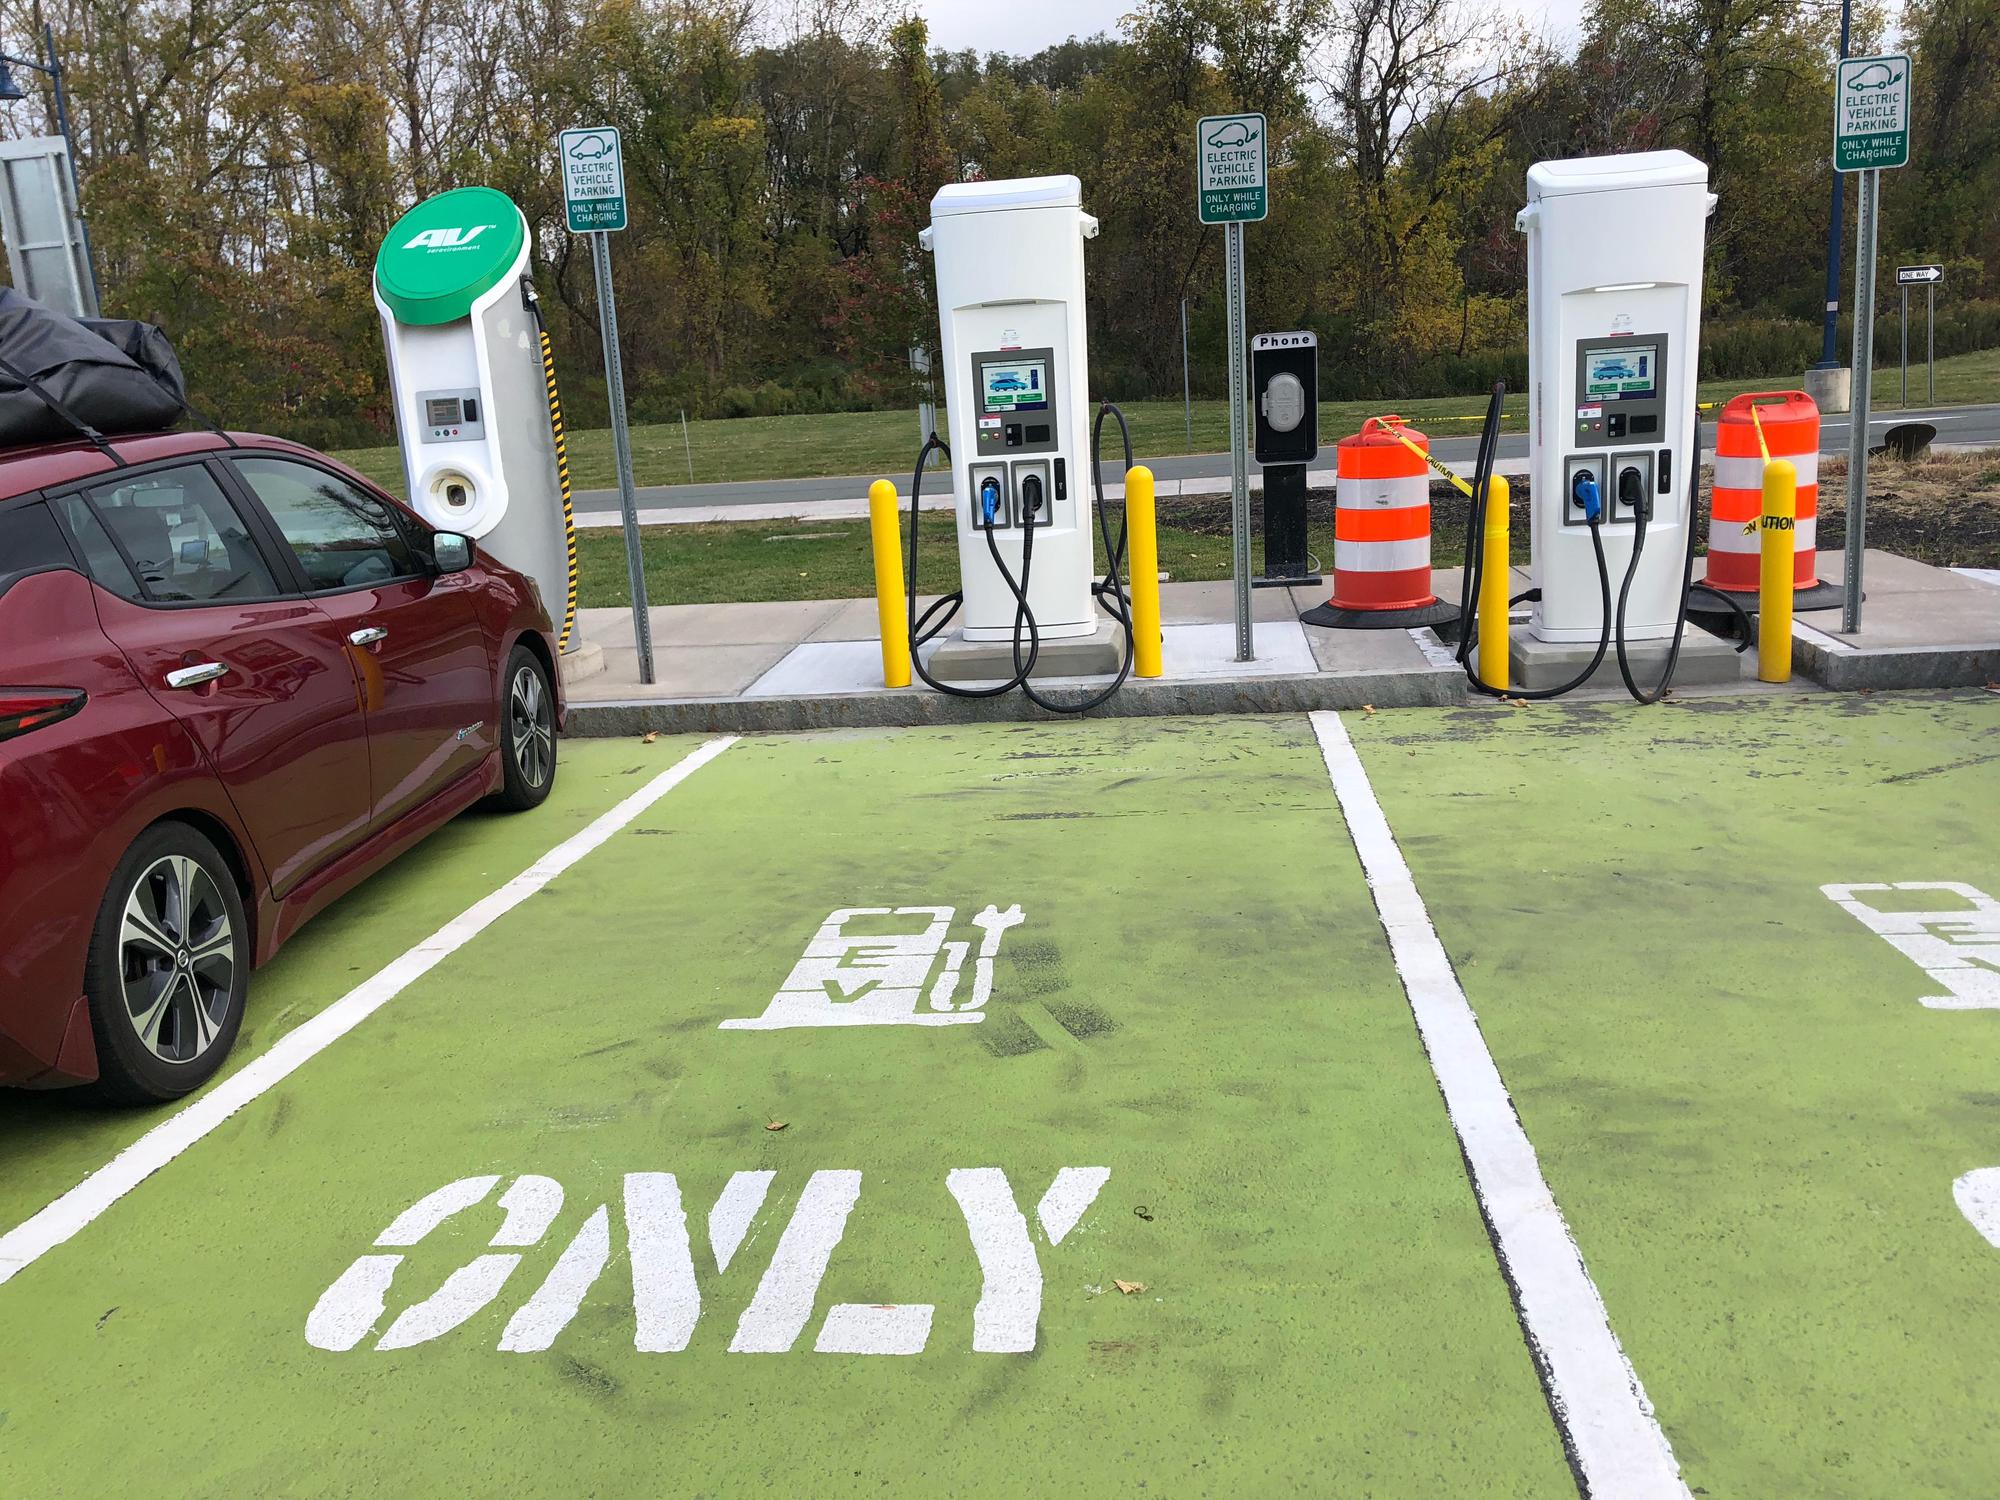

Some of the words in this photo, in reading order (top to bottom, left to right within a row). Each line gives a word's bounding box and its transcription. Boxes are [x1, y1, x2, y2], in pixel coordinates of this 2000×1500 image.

[1846, 92, 1900, 107] ELECTRIC
[1848, 105, 1897, 119] VEHICLE
[1847, 118, 1898, 132] PARKING
[1841, 139, 1868, 150] ONLY
[1871, 136, 1902, 147] WHILE
[1207, 150, 1257, 163] ELECTRIC
[1846, 148, 1897, 160] CHARGING
[570, 162, 614, 174] ELECTRIC
[1209, 162, 1255, 175] VEHICLE
[573, 173, 613, 185] VEHICLE
[1209, 174, 1256, 187] PARKING
[574, 185, 615, 197] PARKING
[1205, 193, 1230, 204] ONLY
[1233, 191, 1261, 202] WHILE
[571, 203, 594, 213] ONLY
[596, 201, 621, 211] WHILE
[1209, 202, 1257, 213] CHARGING
[576, 212, 618, 222] CHARGING
[1901, 271, 1914, 279] ONE
[1260, 336, 1310, 347] Phone
[1424, 454, 1454, 480] CAUTION
[304, 1165, 1112, 1355] ONLY
